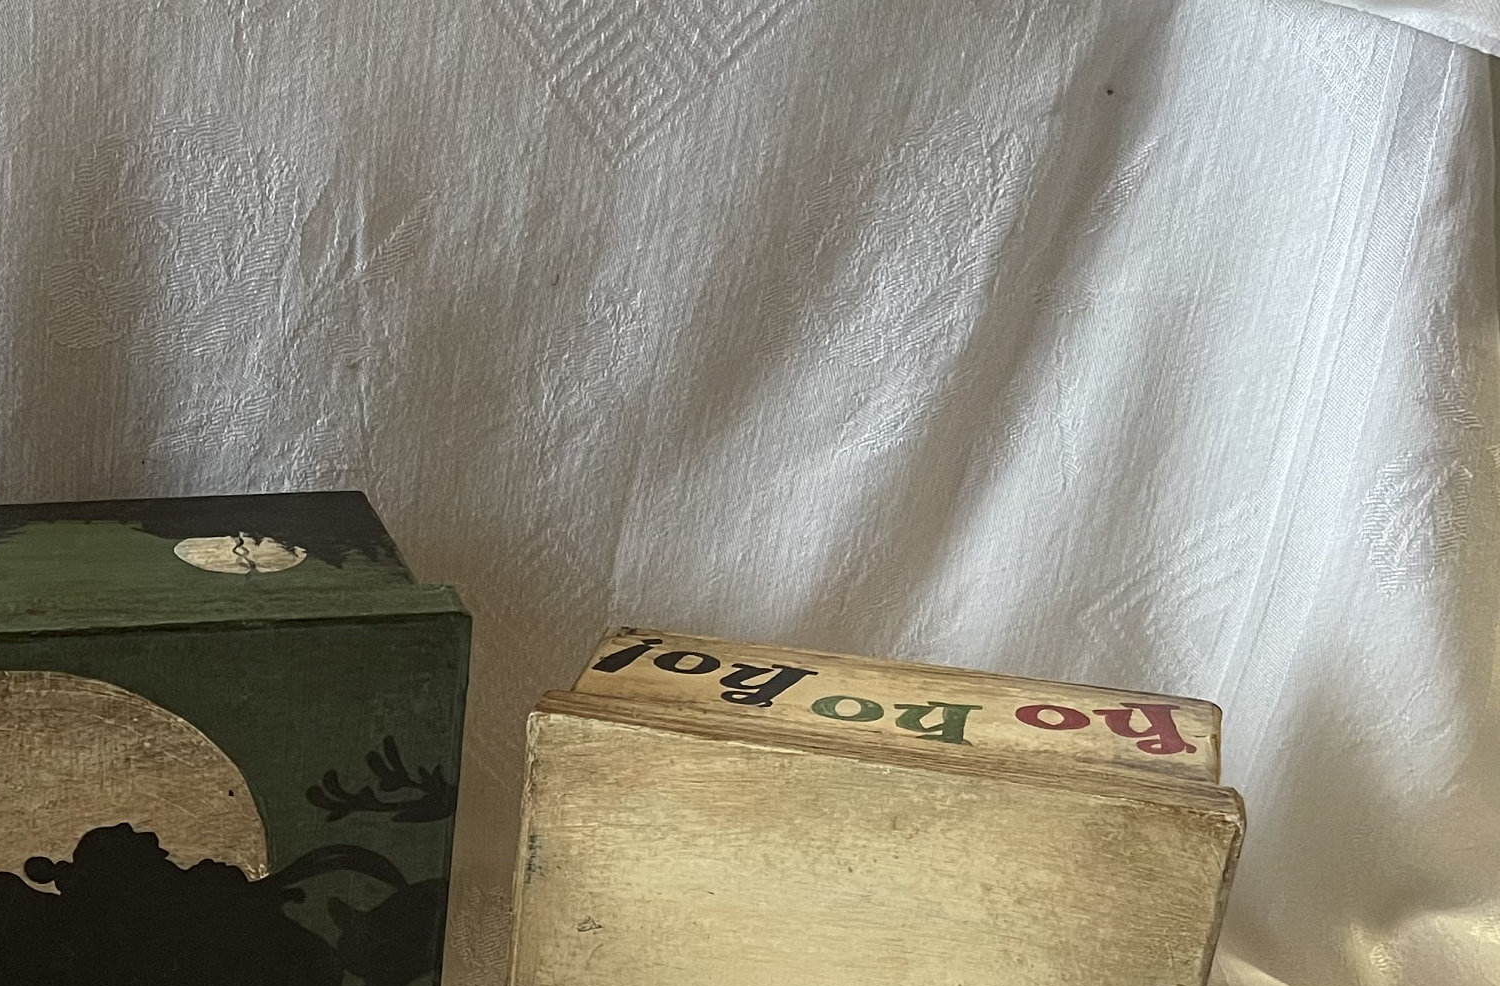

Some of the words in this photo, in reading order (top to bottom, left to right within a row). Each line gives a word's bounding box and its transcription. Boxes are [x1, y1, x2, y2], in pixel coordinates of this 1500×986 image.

[592, 638, 818, 708] ho!
[810, 695, 983, 746] ho
[1015, 702, 1198, 755] ho
